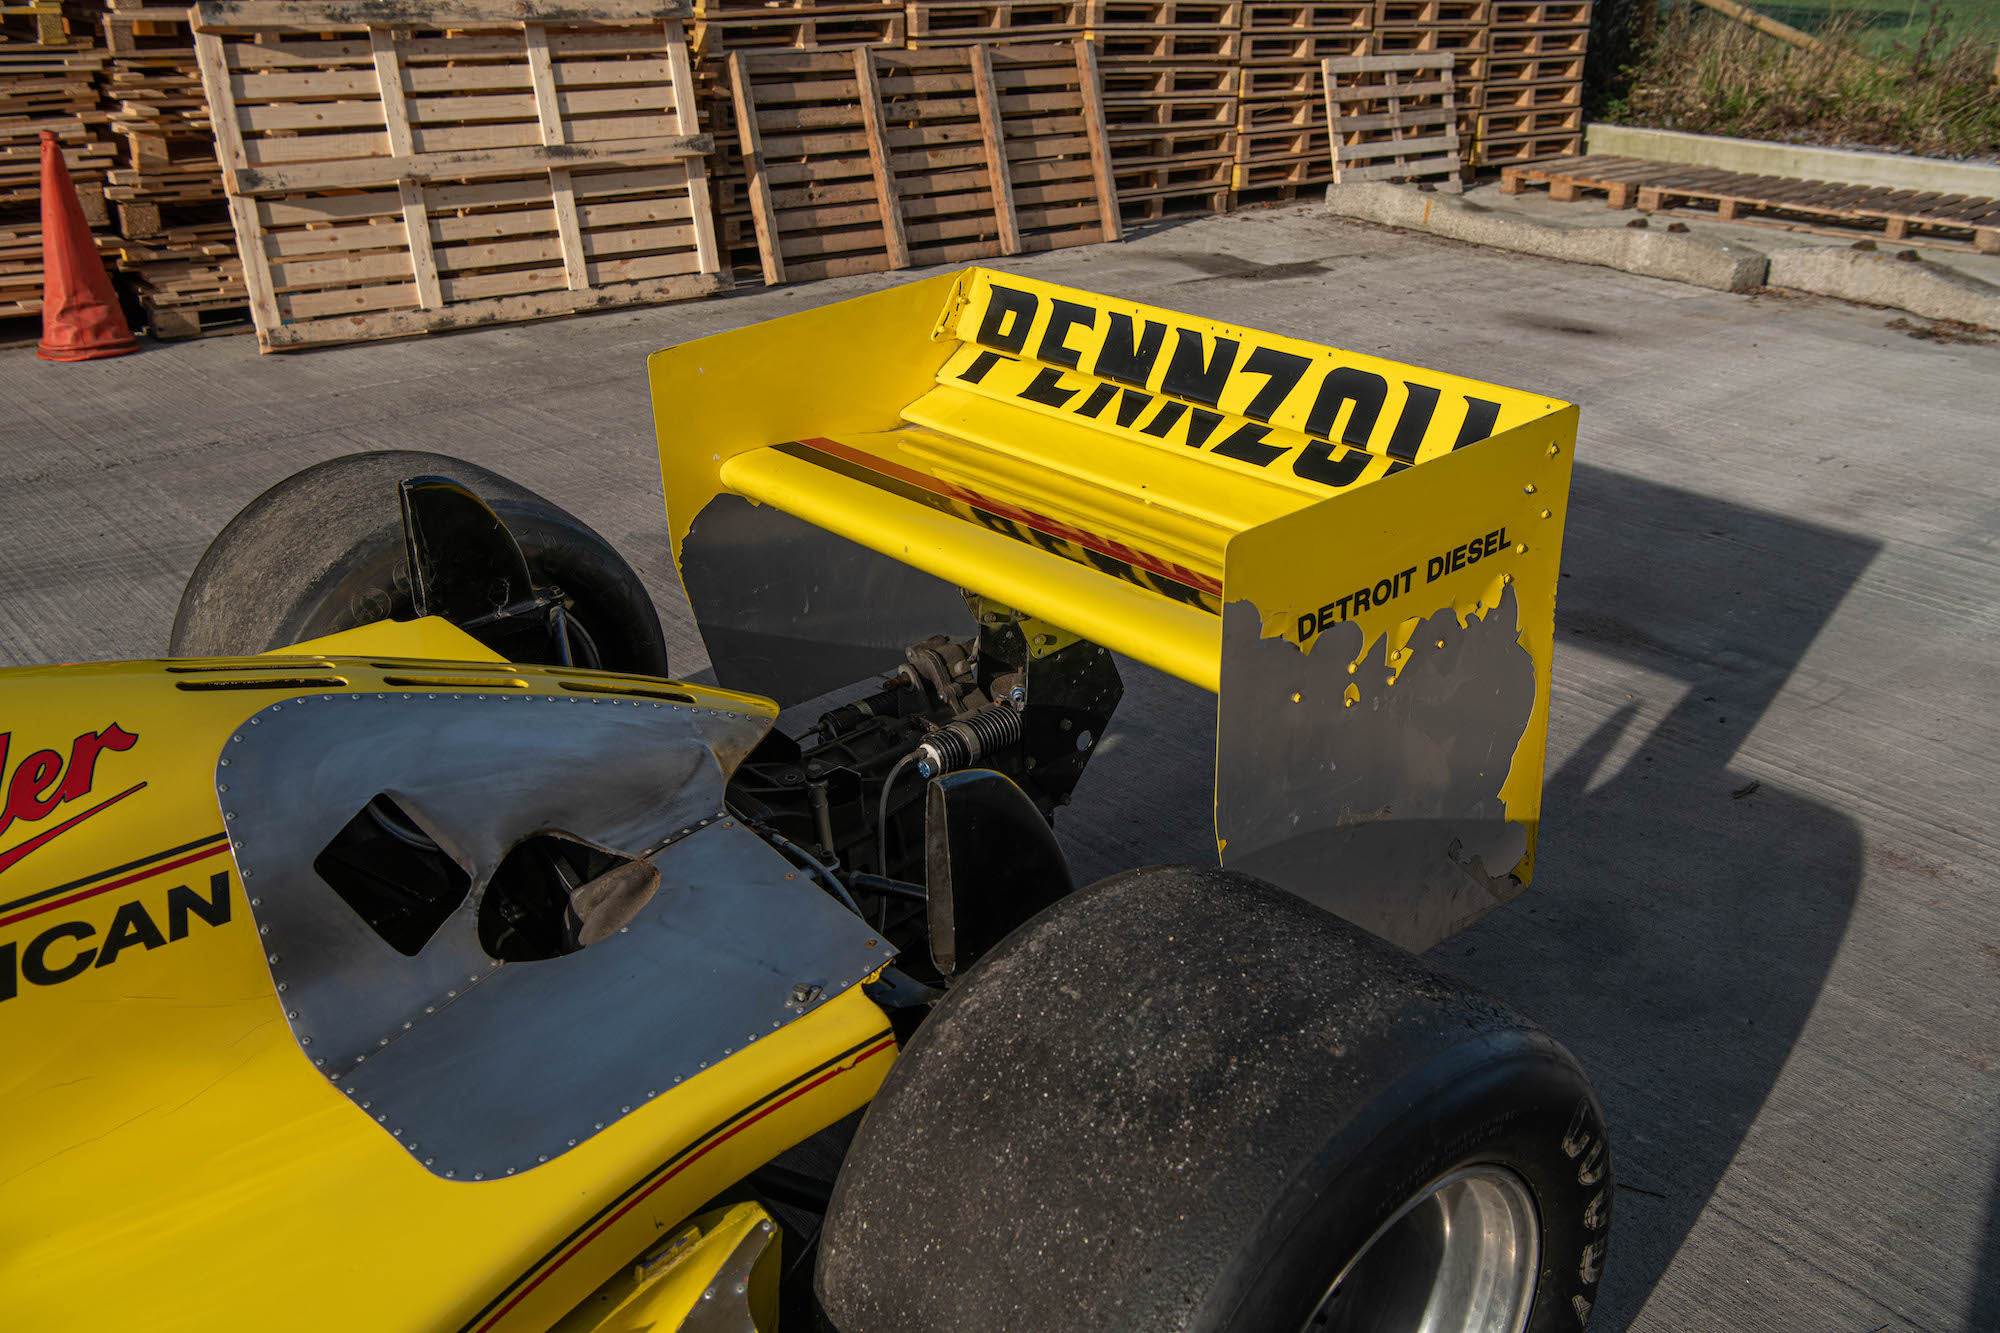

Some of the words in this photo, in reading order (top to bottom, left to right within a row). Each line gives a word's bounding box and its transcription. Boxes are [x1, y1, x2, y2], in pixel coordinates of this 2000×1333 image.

[1297, 566, 1417, 643] DETROIT
[1427, 526, 1512, 584] DIESEL
[0, 721, 139, 837] er
